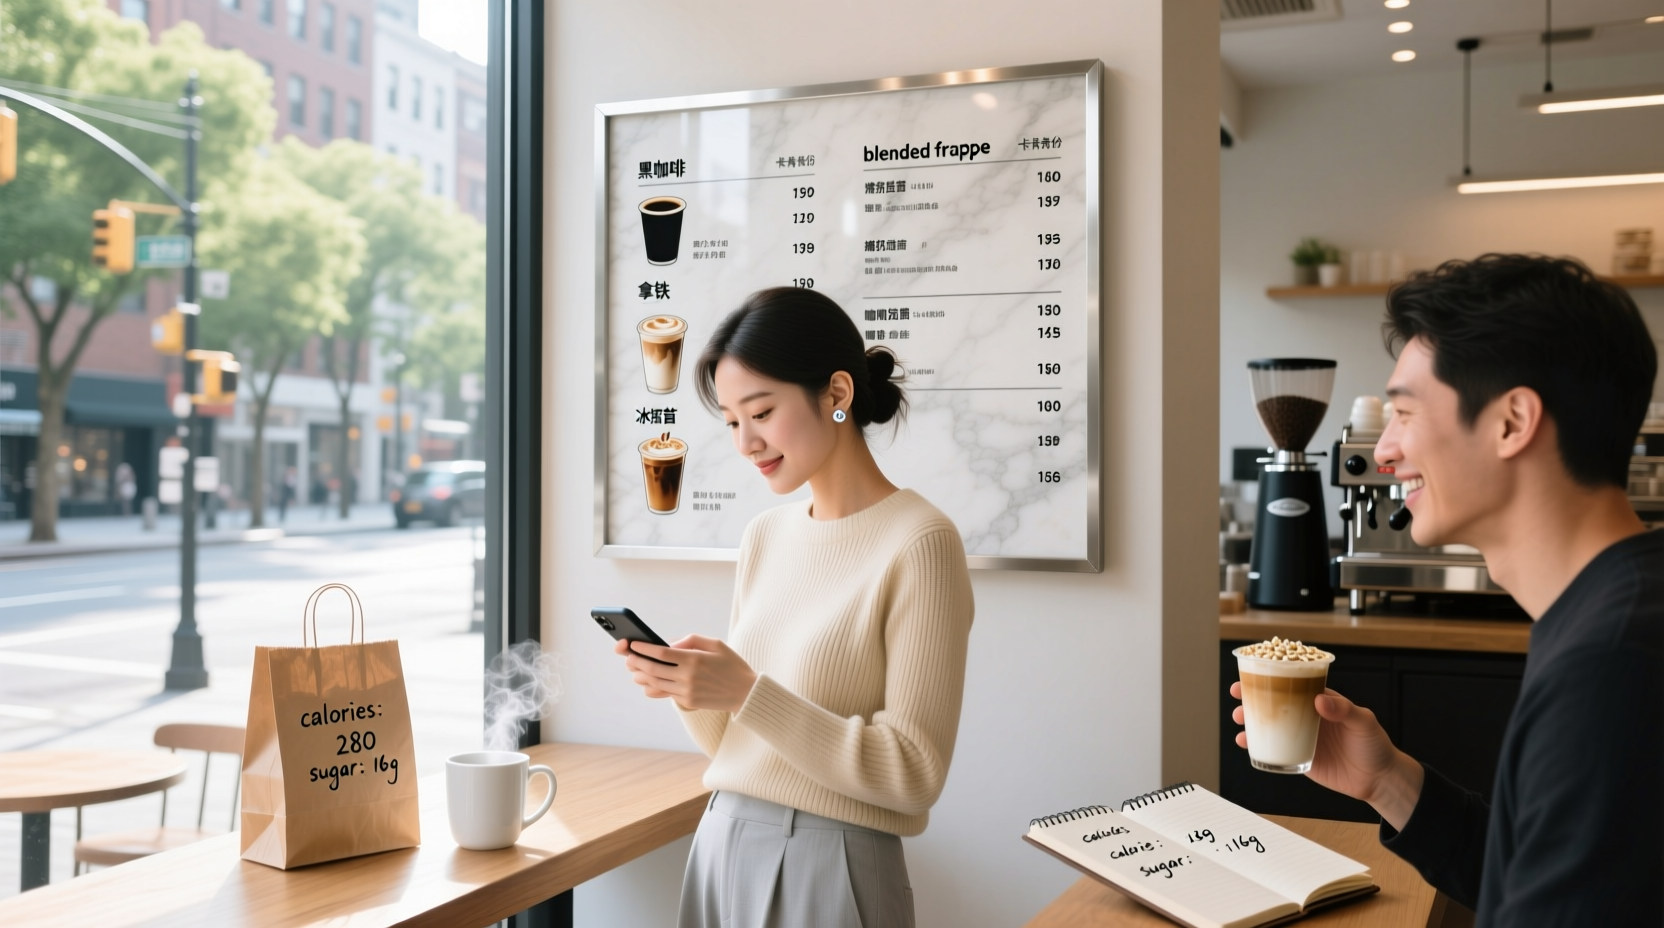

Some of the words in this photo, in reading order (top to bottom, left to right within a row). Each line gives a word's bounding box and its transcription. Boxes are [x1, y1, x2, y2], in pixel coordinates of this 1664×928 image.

[863, 141, 931, 163] blended
[934, 140, 991, 162] frappe
[300, 701, 383, 728] calories:
[336, 730, 377, 756] 280
[309, 761, 366, 791] sugar:
[373, 754, 399, 785] 16g
